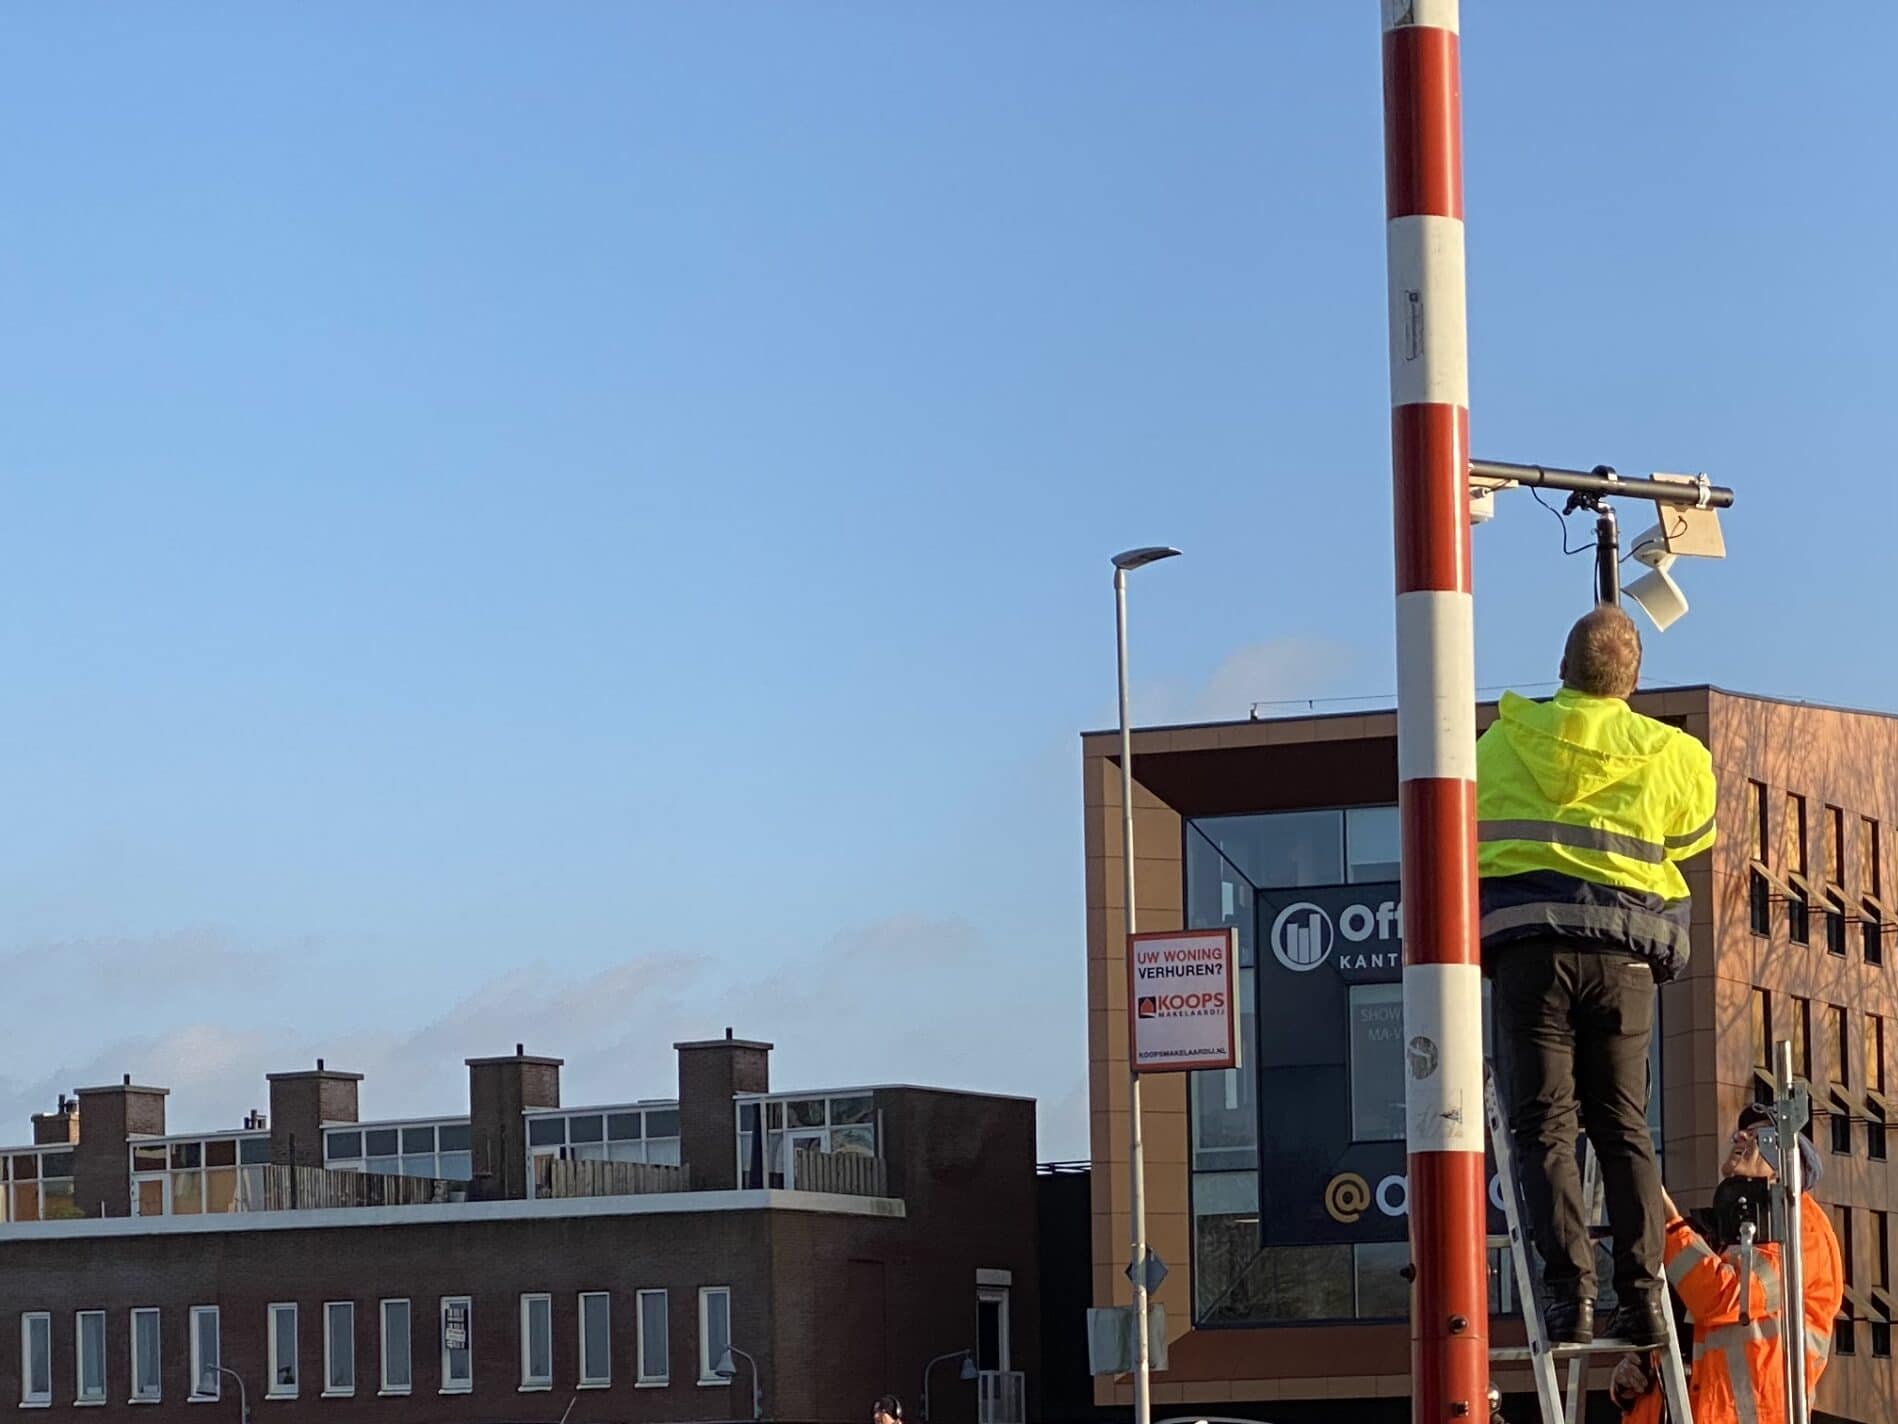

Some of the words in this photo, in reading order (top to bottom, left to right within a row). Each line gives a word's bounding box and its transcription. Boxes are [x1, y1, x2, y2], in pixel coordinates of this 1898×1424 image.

[1137, 951, 1159, 964] UW
[1164, 948, 1223, 962] WONING
[1138, 963, 1223, 979] VERHUREN?
[1158, 992, 1225, 1011] KOOPS
